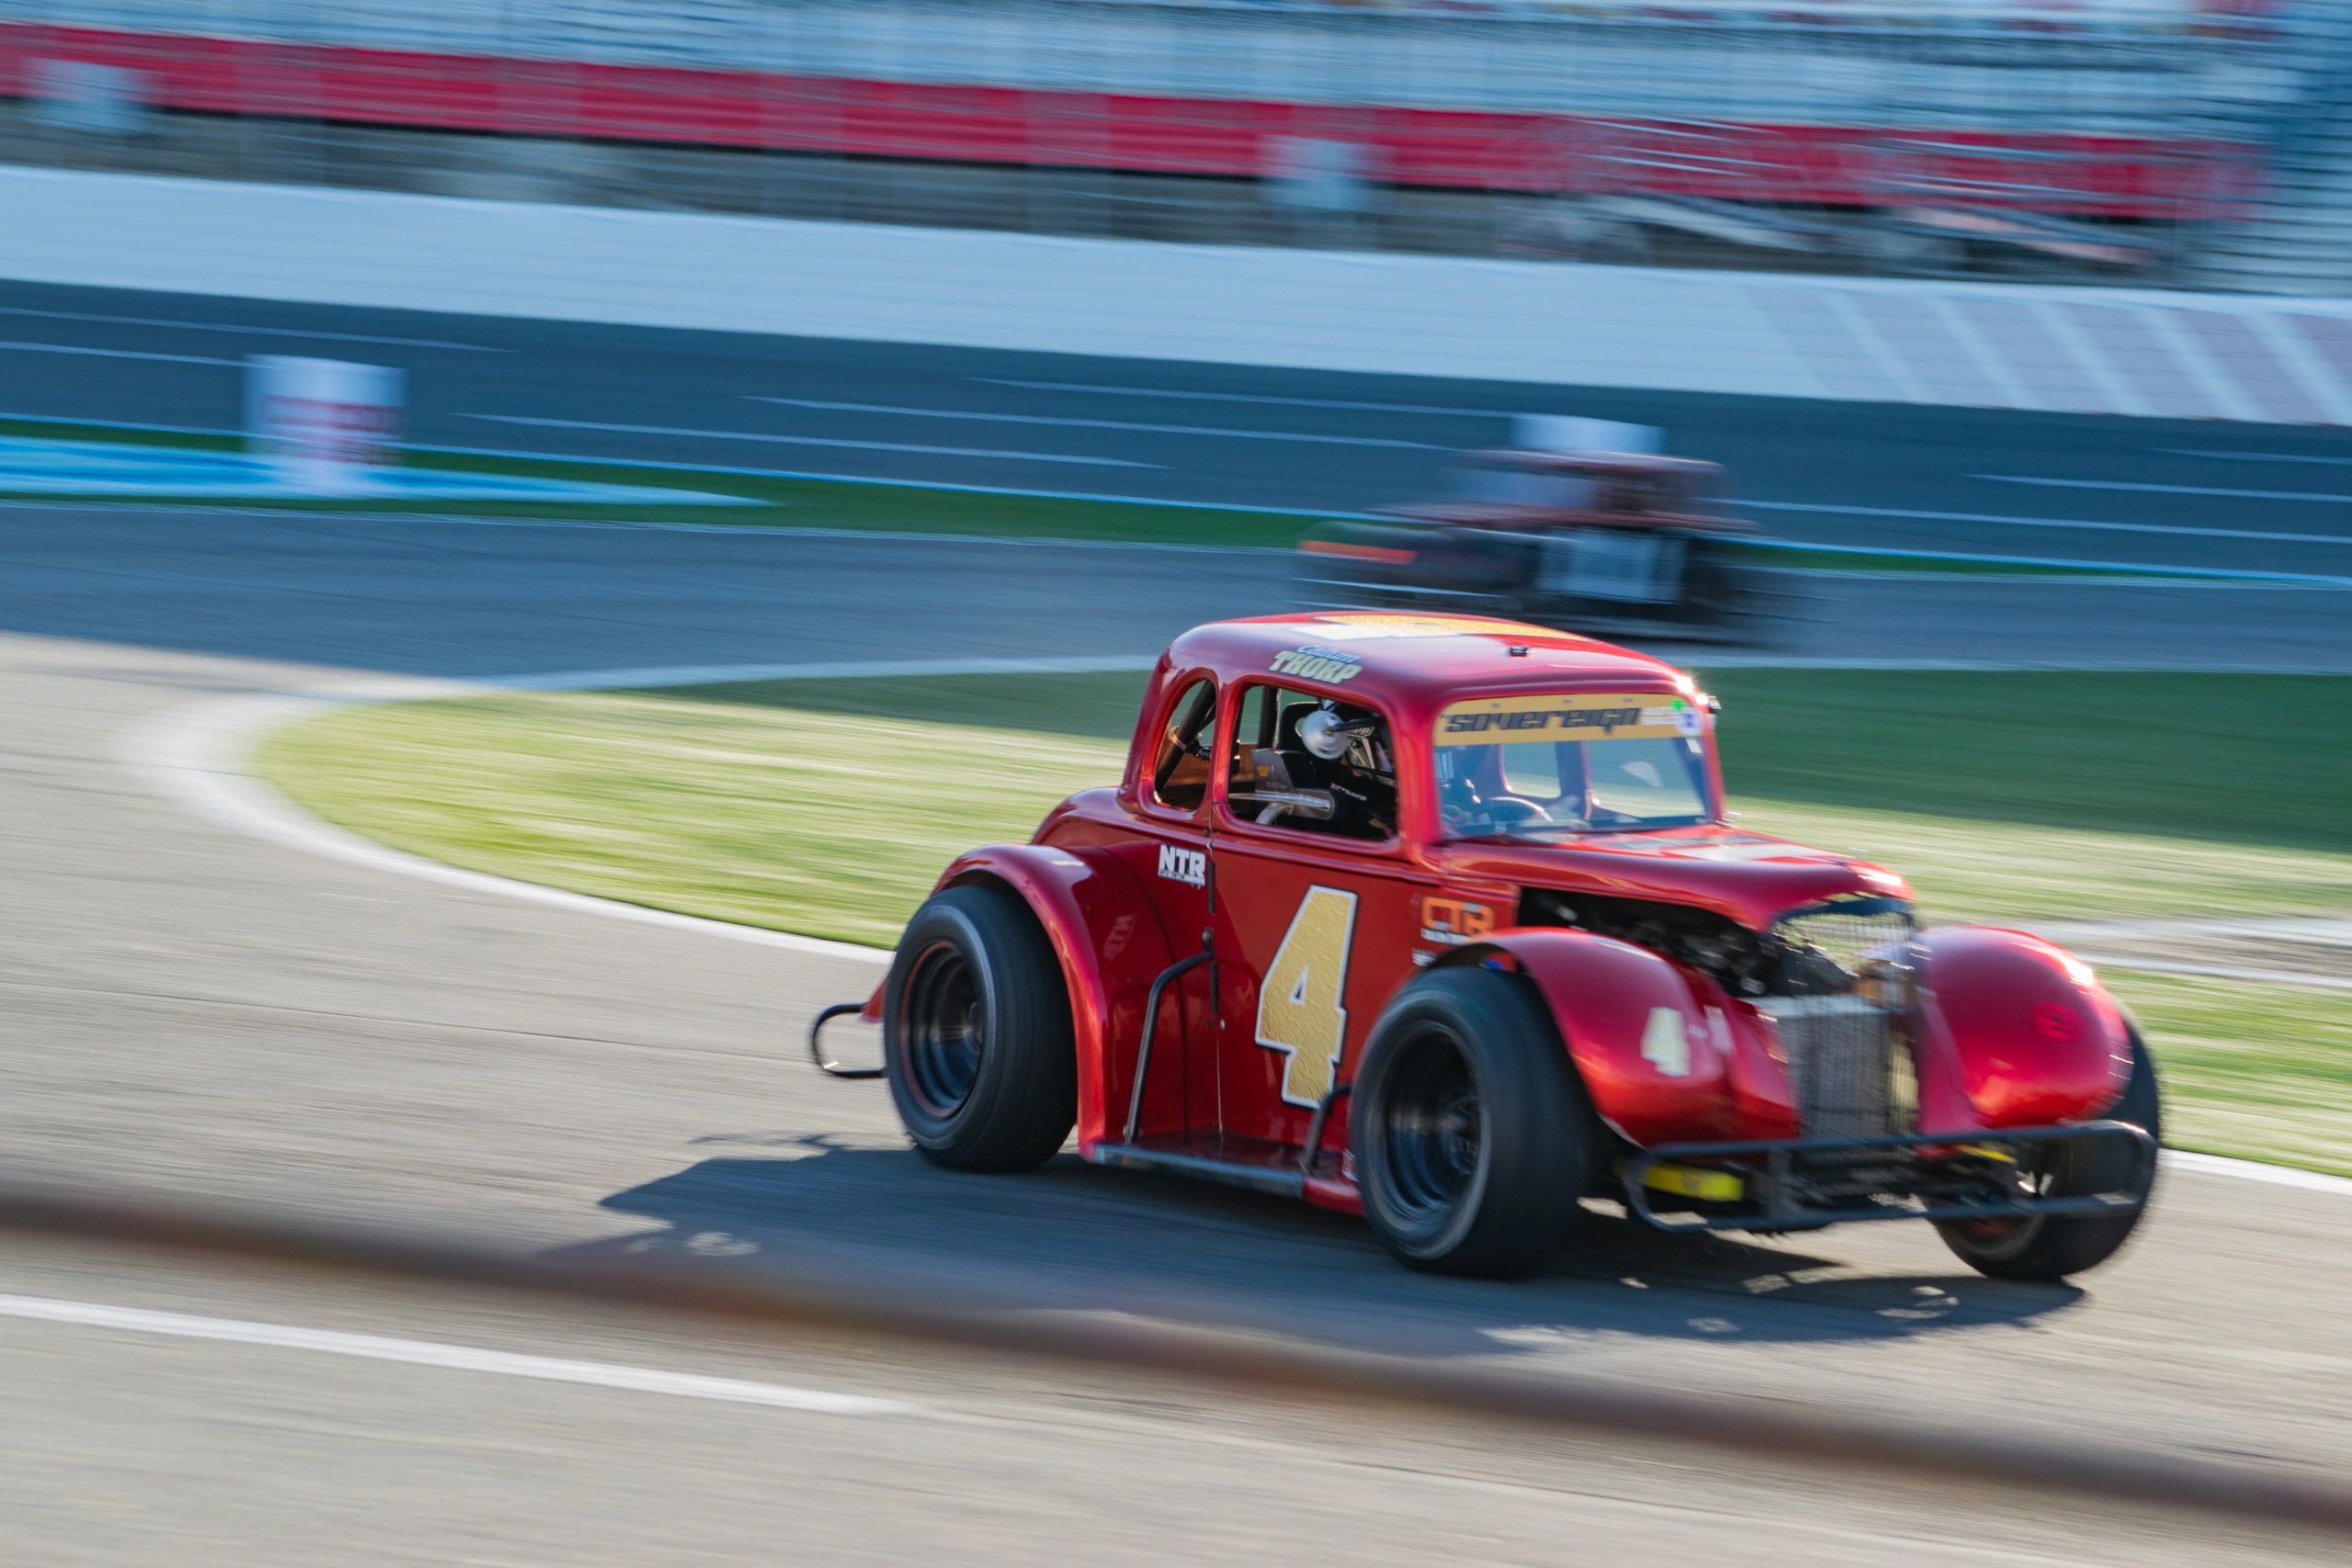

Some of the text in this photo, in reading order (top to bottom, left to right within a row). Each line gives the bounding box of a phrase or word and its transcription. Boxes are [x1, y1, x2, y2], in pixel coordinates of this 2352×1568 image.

[1268, 649, 1363, 684] THORP
[1158, 843, 1206, 879] NTR
[1256, 883, 1358, 1109] 4
